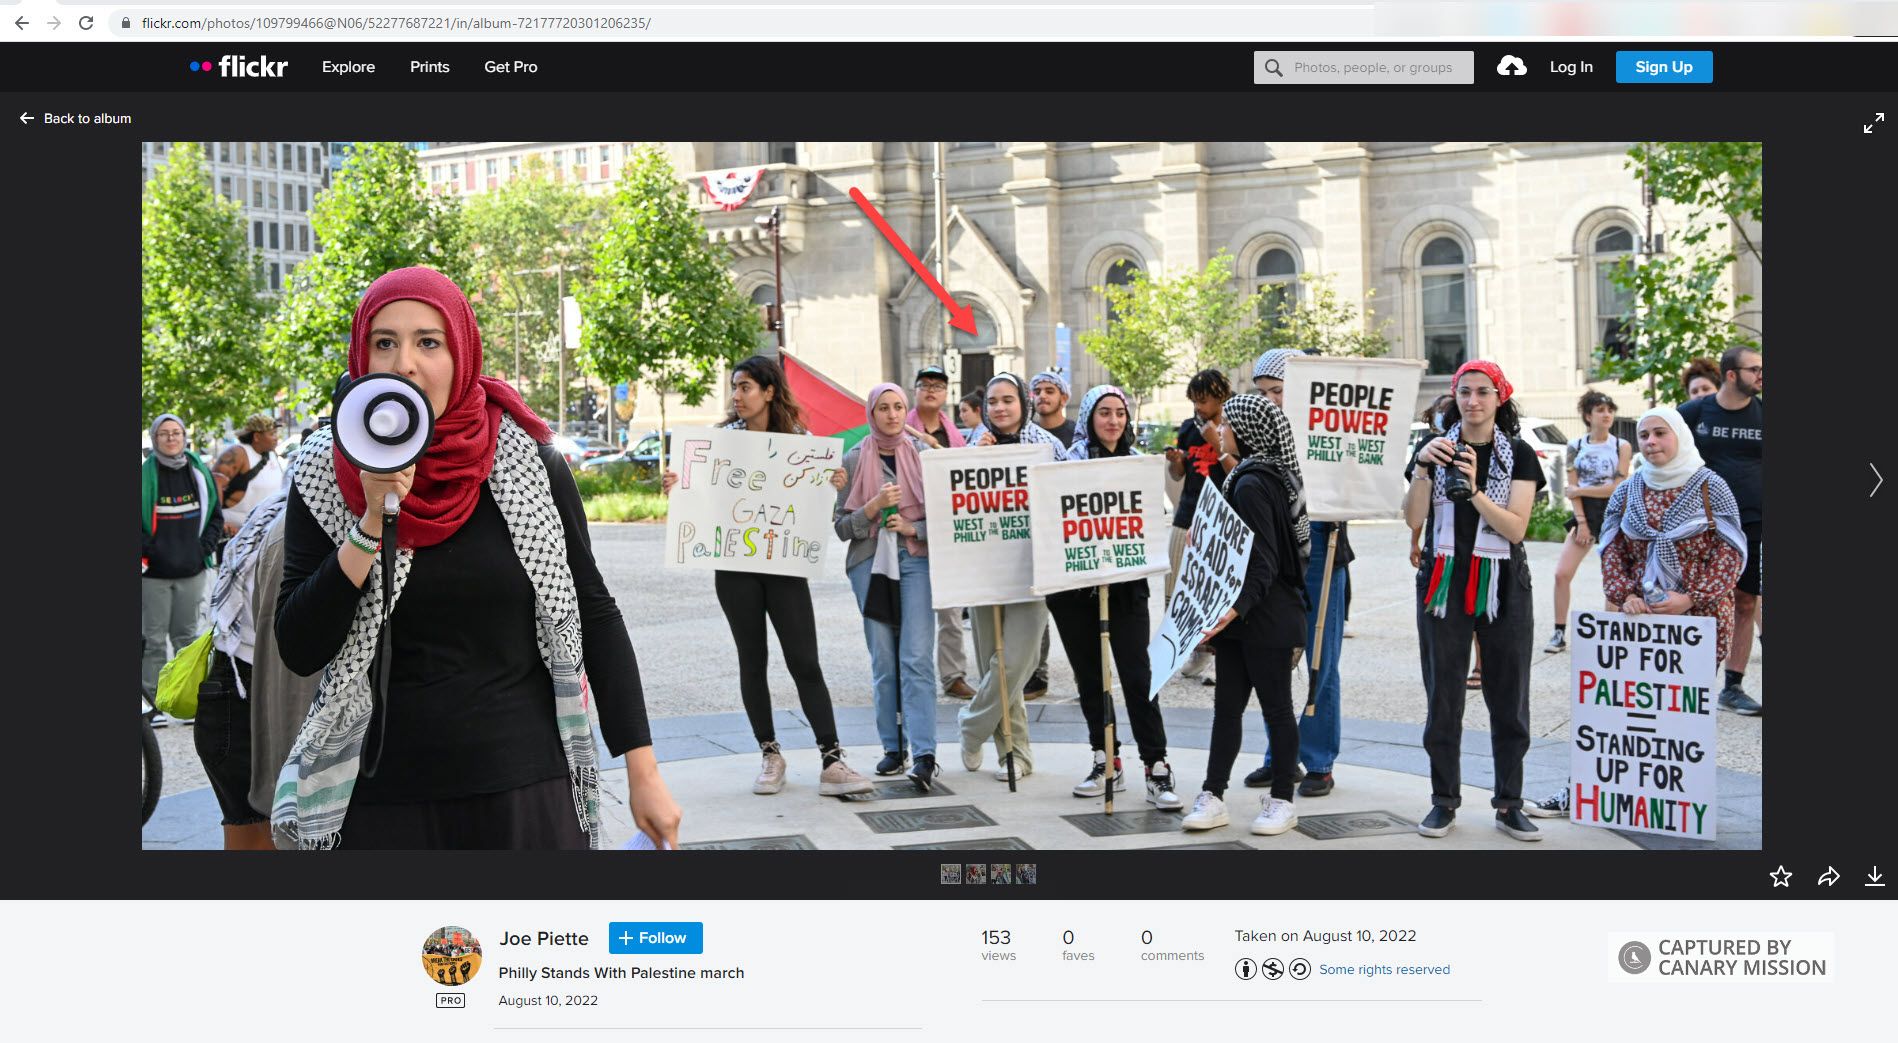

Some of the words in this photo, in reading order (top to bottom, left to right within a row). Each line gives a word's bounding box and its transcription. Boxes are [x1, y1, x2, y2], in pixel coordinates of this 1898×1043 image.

[141, 16, 652, 32] flickr.com/photos/109799466@N06/52277687221/in/album-72177720301206235/
[218, 55, 288, 78] flickr
[322, 60, 376, 76] Explore
[410, 60, 450, 74] Prints
[484, 60, 509, 74] Get
[515, 60, 538, 74] Pro
[1295, 62, 1339, 75] Photos,
[1344, 62, 1390, 76] people,
[1395, 64, 1406, 73] or
[1410, 64, 1453, 76] groups
[1550, 60, 1577, 77] Log
[1581, 60, 1594, 73] In
[1635, 60, 1669, 77] Sign
[1672, 61, 1694, 77] Up
[44, 112, 75, 125] Back
[78, 113, 90, 125] to
[93, 112, 132, 125] album
[1310, 381, 1394, 410] PEOPLE
[1308, 407, 1388, 436] POWER
[1712, 426, 1730, 438] BE
[1731, 428, 1762, 441] FREE
[1308, 434, 1342, 449] WEST
[1358, 438, 1385, 453] WEST
[1307, 449, 1343, 462] PHILLY
[1358, 453, 1383, 465] BANK
[681, 439, 767, 491] Free
[950, 466, 1028, 491] PEOPLE
[952, 489, 1030, 516] POWER
[1060, 490, 1143, 518] PEOPLE
[732, 498, 796, 526] GAZA
[953, 518, 984, 532] WEST
[999, 515, 1030, 529] WEST
[1199, 484, 1217, 518] NO
[1213, 501, 1249, 556] MORE
[953, 531, 987, 543] PHILLY
[1001, 528, 1031, 541] BANK
[1063, 516, 1145, 543] POWER
[1064, 545, 1097, 561] WEST
[1112, 543, 1145, 557] WEST
[1065, 558, 1100, 573] PHILLY
[1115, 556, 1147, 568] BANK
[1202, 534, 1229, 577] AID
[1225, 564, 1242, 594] for
[1181, 551, 1231, 628] ISRAEL'S
[1576, 612, 1703, 647] STANDING
[1597, 644, 1629, 670] UP
[1639, 647, 1684, 674] FOR
[1579, 670, 1710, 715] PALESTINE
[1575, 724, 1705, 764] STANDING
[1596, 757, 1629, 785] UP
[1639, 761, 1685, 793] FOR
[1575, 782, 1708, 835] HUMANITY
[499, 930, 532, 946] Joe
[537, 930, 590, 946] Piette
[638, 931, 687, 945] Follow
[981, 930, 1011, 945] 153
[1062, 930, 1075, 945] 0
[1141, 930, 1153, 945] 0
[1235, 929, 1276, 942] Taken
[1281, 932, 1299, 943] on
[1303, 929, 1353, 945] August
[1357, 930, 1375, 944] 10,
[1378, 930, 1417, 942] 2022
[981, 950, 1017, 961] views
[1062, 949, 1095, 961] faves
[1141, 950, 1205, 961] comments
[499, 966, 538, 982] Philly
[541, 966, 590, 979] Stands
[594, 966, 627, 979] With
[631, 966, 697, 979] Palestine
[700, 966, 745, 979] march
[1320, 963, 1355, 975] Some
[1358, 963, 1393, 978] rights
[1396, 964, 1451, 975] reserved
[440, 996, 462, 1005] PRO
[499, 994, 543, 1009] August
[545, 994, 562, 1008] 10,
[564, 994, 599, 1006] 2022
